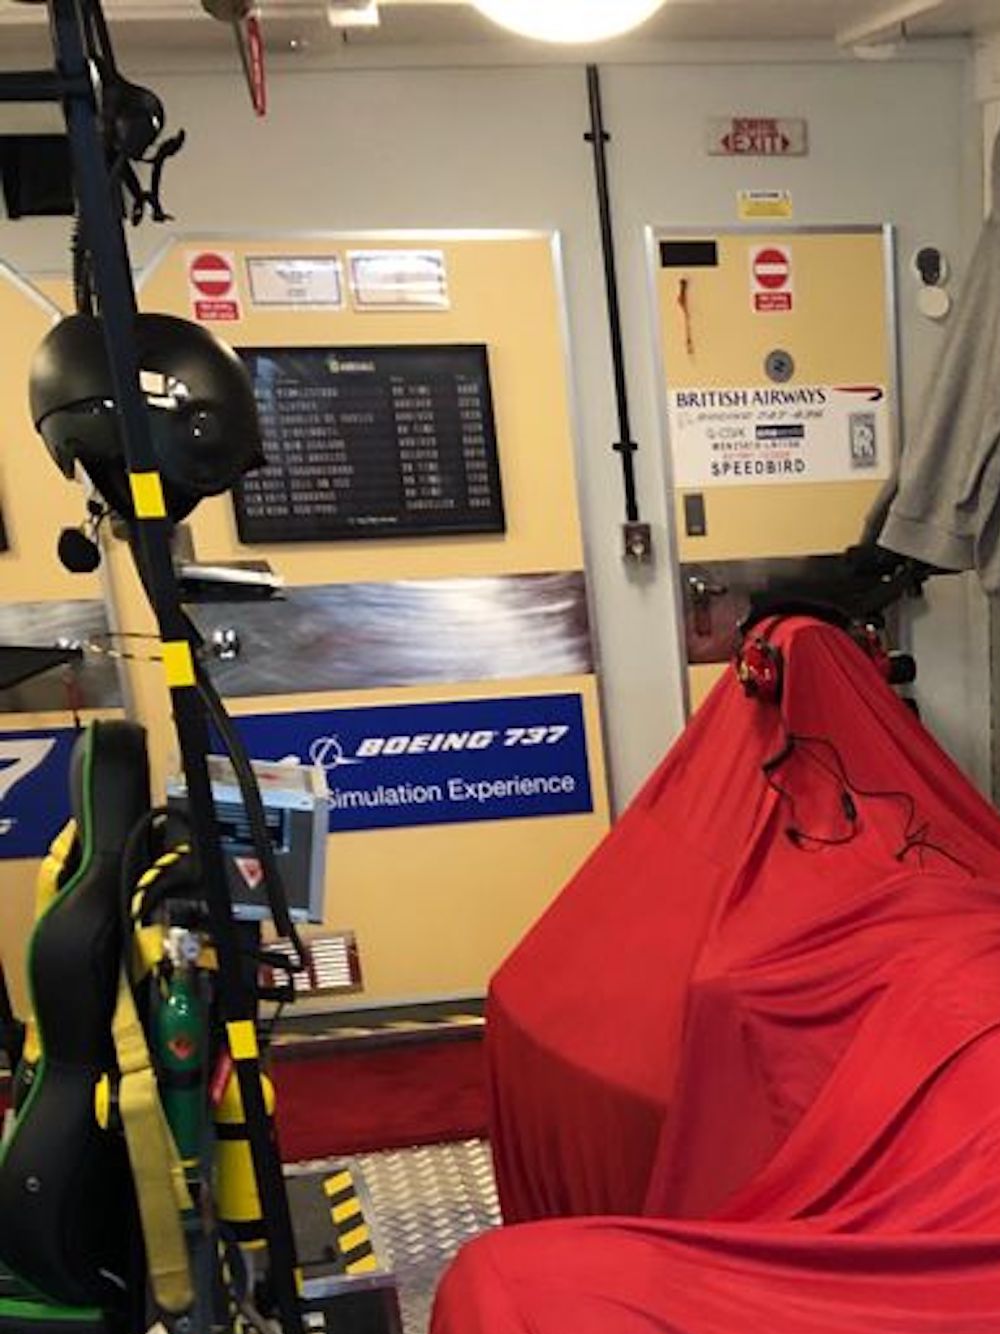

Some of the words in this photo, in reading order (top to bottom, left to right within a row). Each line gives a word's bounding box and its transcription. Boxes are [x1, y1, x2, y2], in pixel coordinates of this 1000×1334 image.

[733, 132, 779, 152] EXIT
[676, 391, 748, 408] BRITISH
[752, 388, 827, 406] AIRWAYS
[711, 458, 806, 476] SPEEDBIRD
[355, 730, 495, 758] BOEING
[503, 725, 569, 747] 737
[448, 773, 575, 802] Experience
